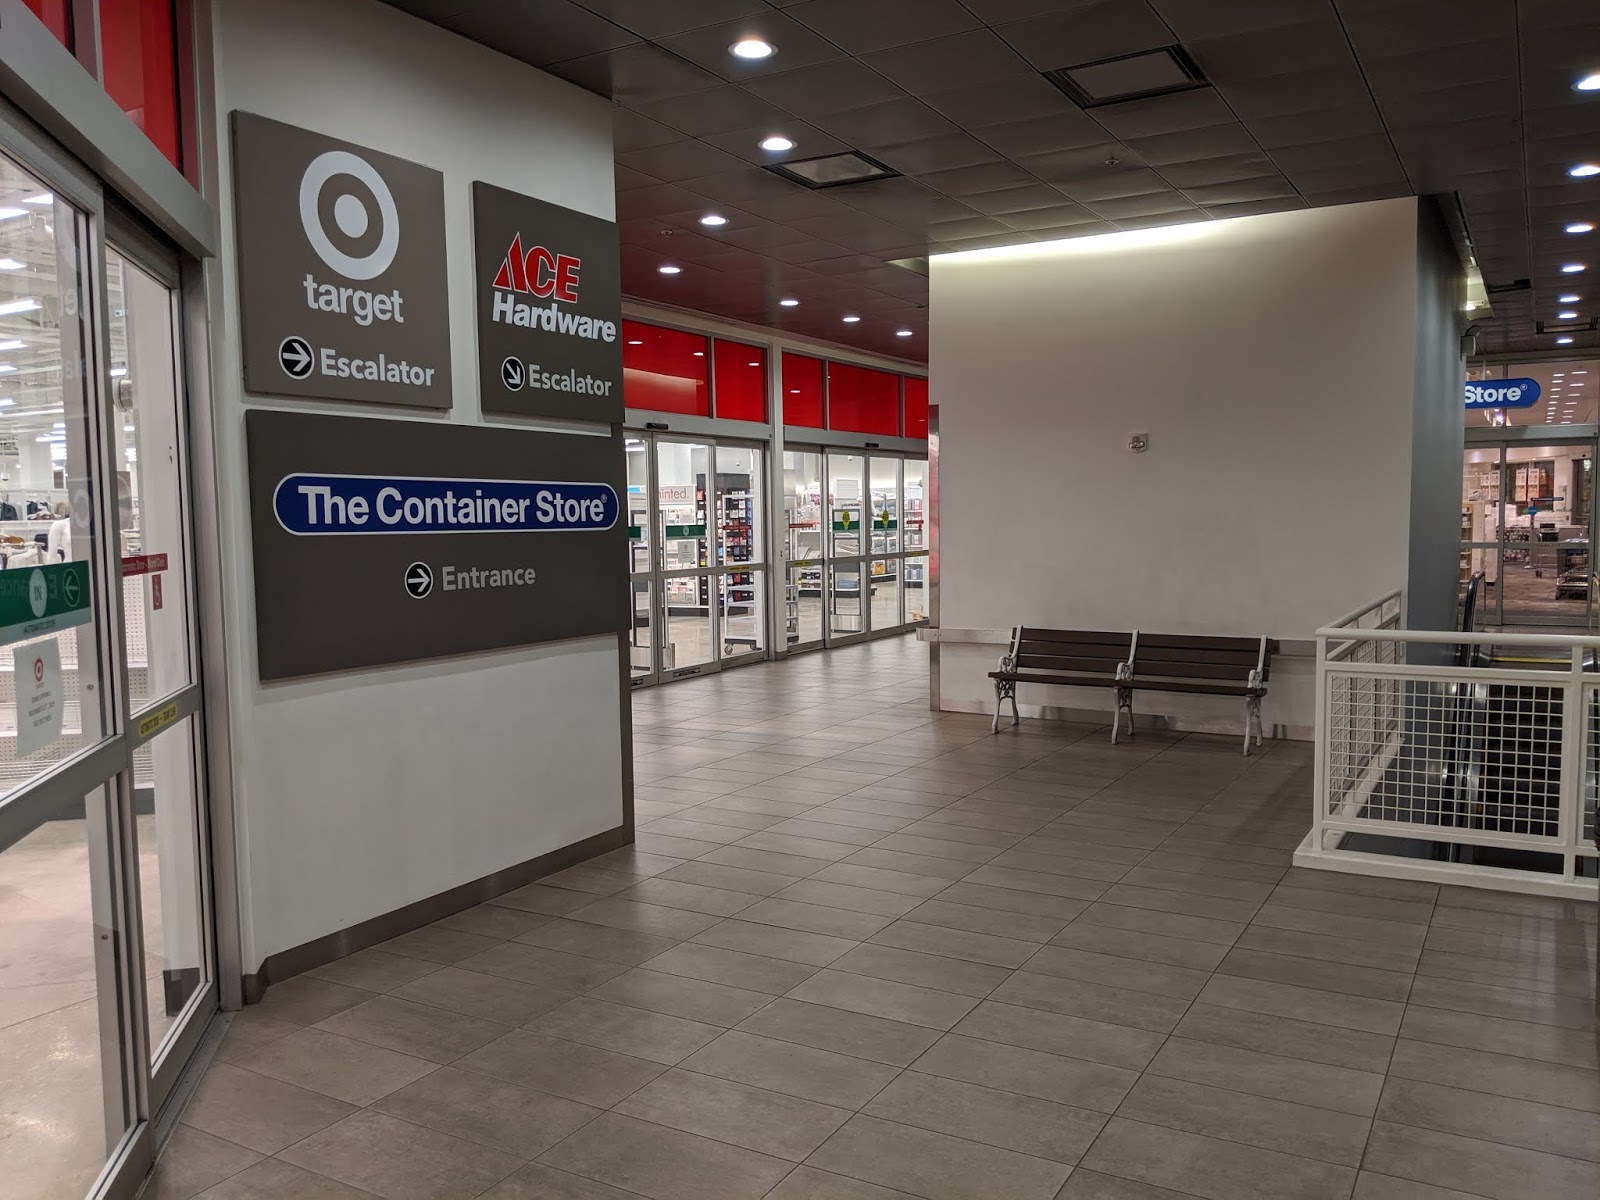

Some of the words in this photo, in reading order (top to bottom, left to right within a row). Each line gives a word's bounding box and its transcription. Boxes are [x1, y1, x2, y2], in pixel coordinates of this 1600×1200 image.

[492, 231, 581, 303] ACE
[303, 274, 404, 326] target
[492, 291, 617, 343] Hardware
[320, 348, 435, 386] Escalator
[528, 363, 612, 396] Escalator
[297, 485, 369, 525] The
[375, 486, 530, 525] Container
[442, 565, 536, 591] Entrance
